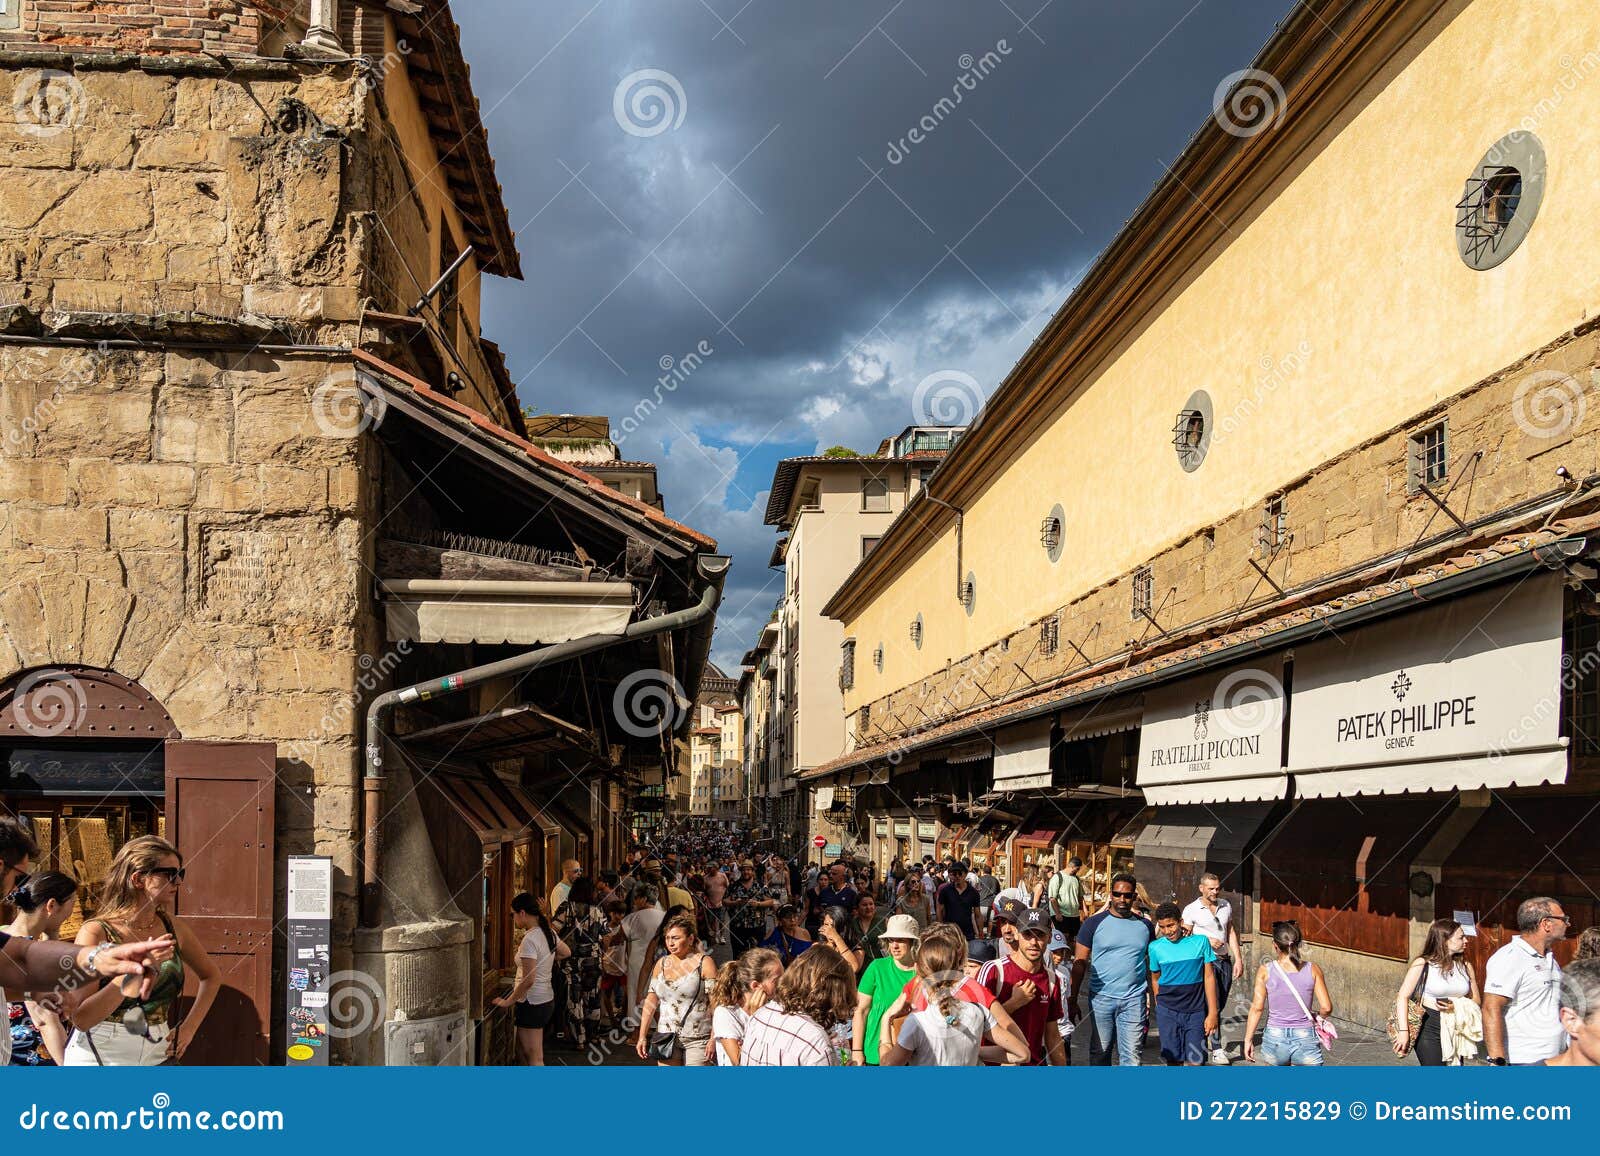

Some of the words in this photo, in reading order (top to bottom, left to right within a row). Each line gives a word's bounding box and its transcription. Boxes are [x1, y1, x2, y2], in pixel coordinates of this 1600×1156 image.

[1337, 711, 1386, 743] PATEK
[1390, 695, 1476, 735] PHILIPPE
[1151, 742, 1205, 767] FRATELLI
[1207, 734, 1261, 760] PICCINI
[1384, 735, 1415, 749] GENEVE
[1188, 761, 1211, 772] FIRENZE
